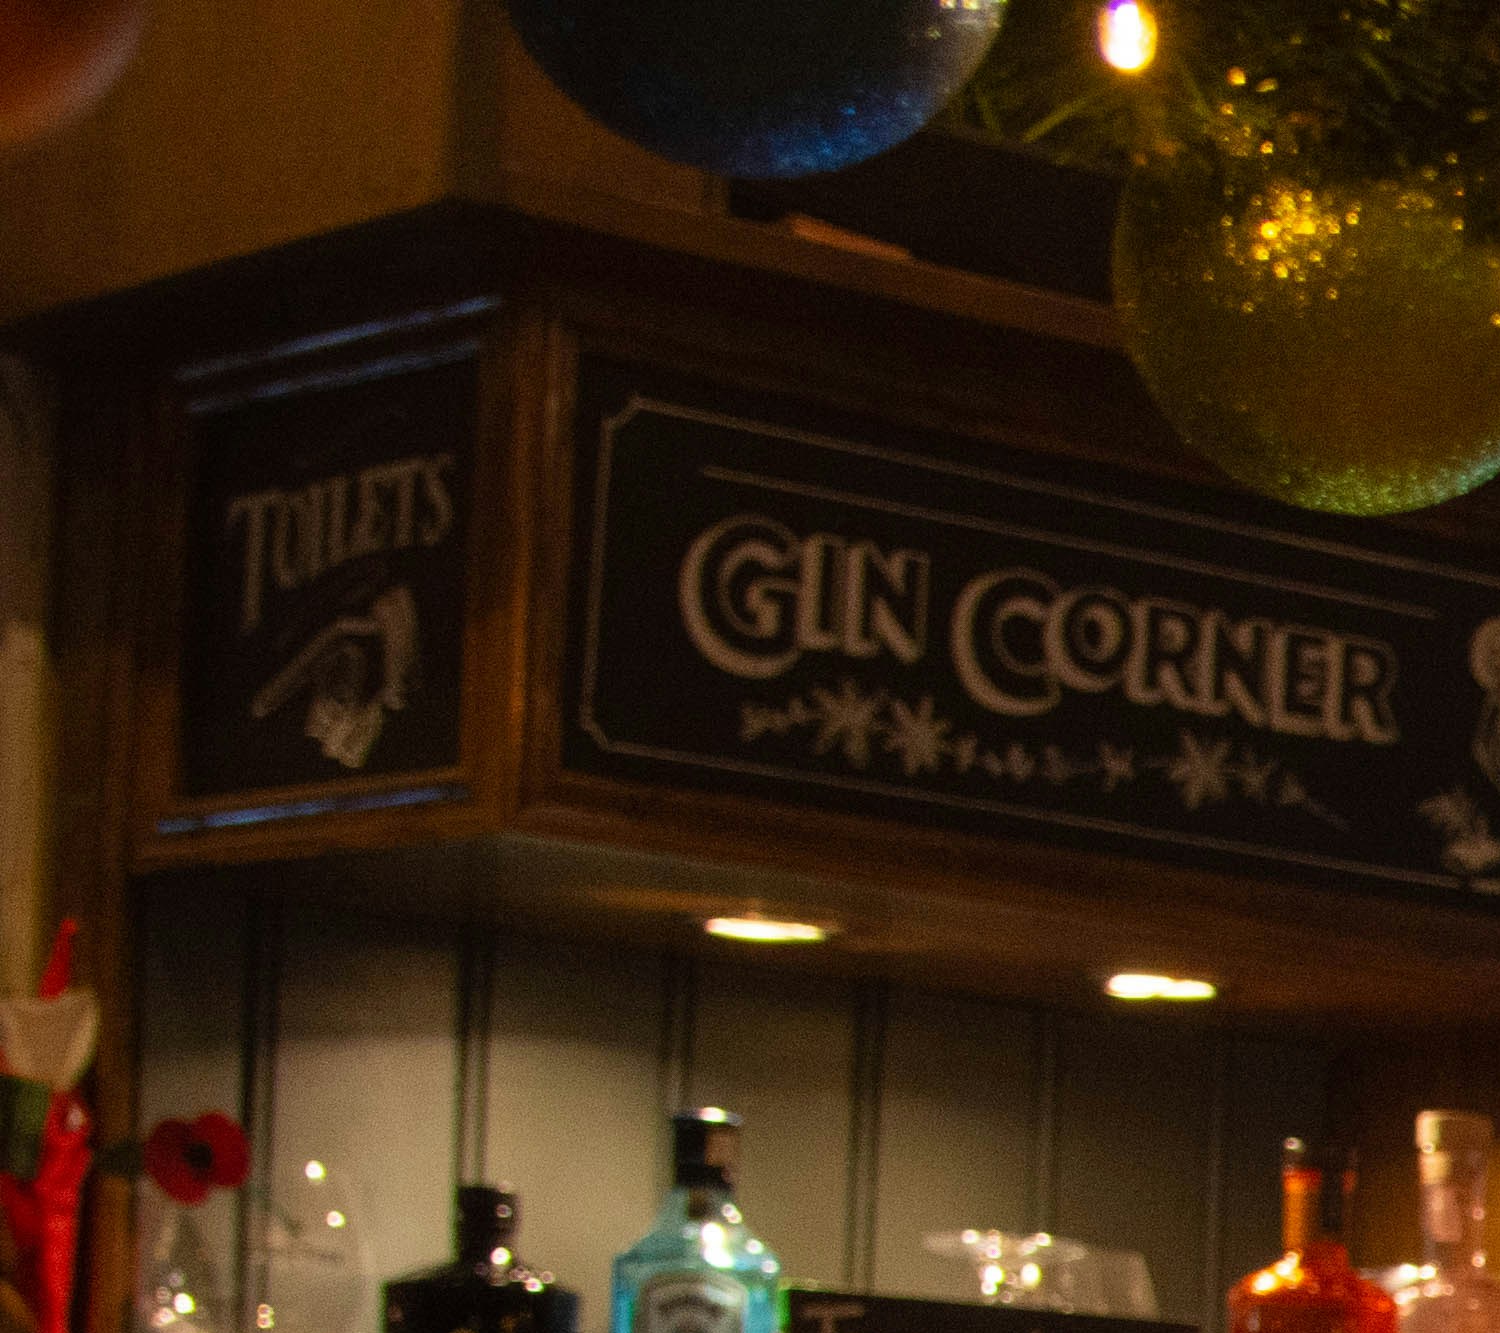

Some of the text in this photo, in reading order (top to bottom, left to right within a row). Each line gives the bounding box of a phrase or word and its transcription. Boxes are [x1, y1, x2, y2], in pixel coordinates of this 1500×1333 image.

[225, 450, 457, 633] TOILETS
[679, 514, 1400, 746] GIN CORNER
